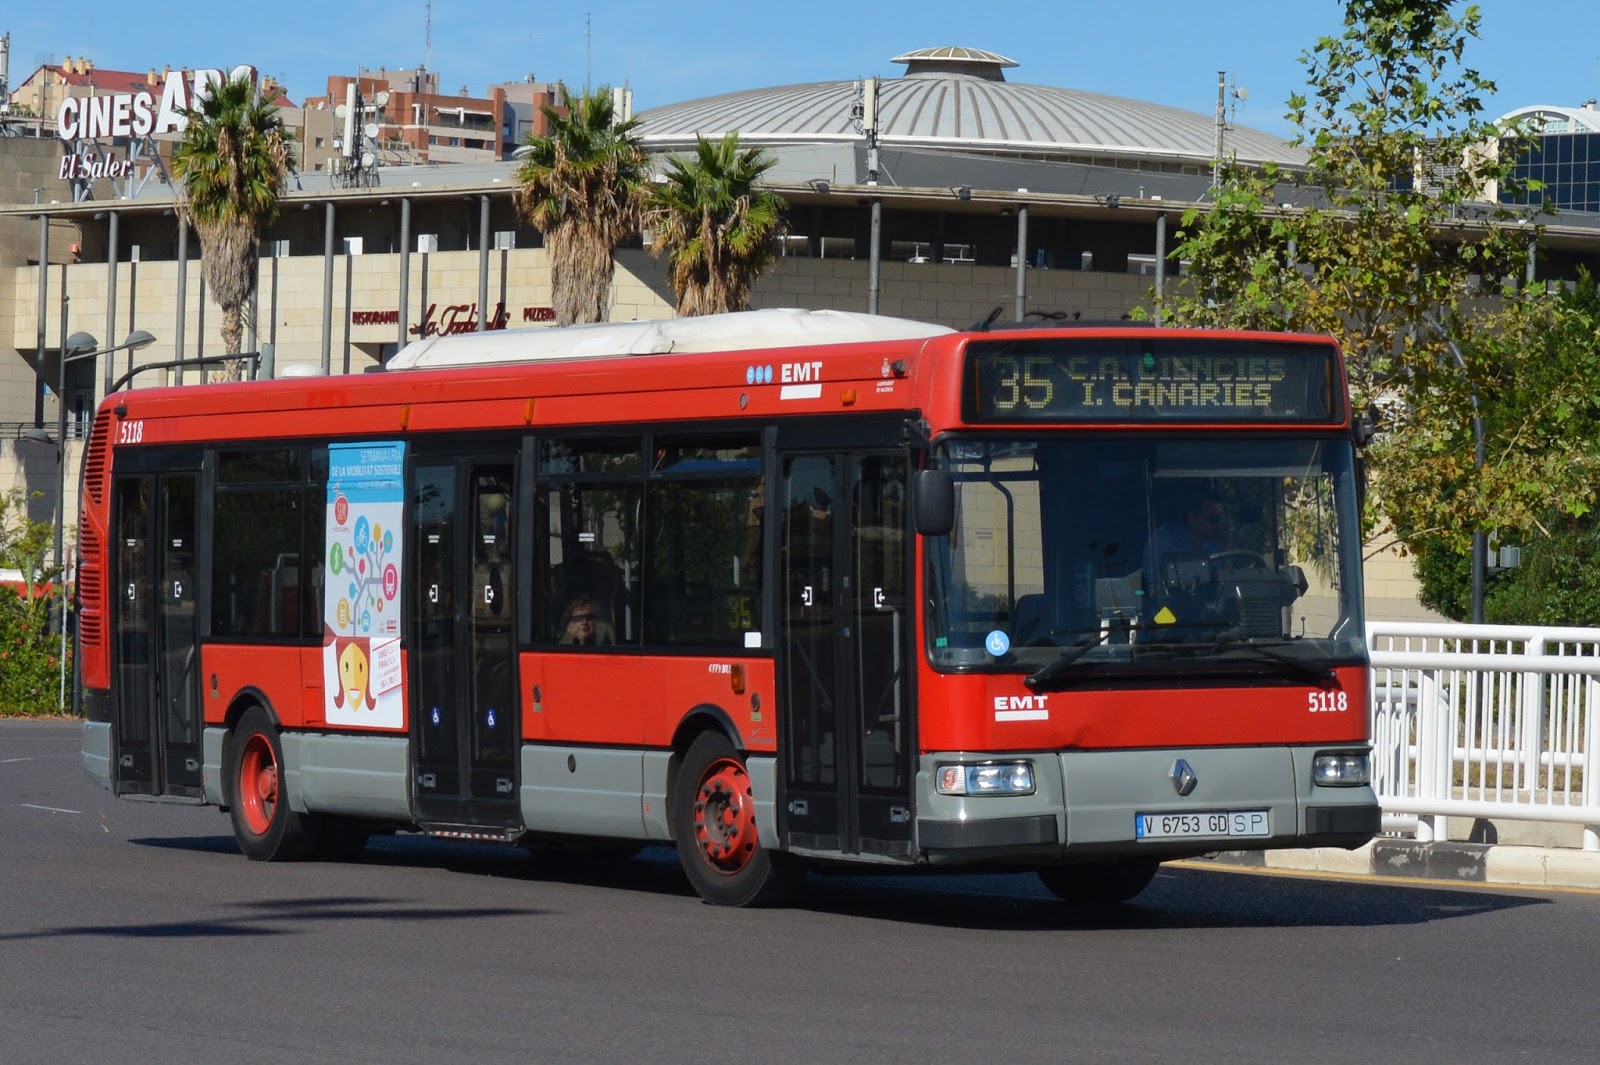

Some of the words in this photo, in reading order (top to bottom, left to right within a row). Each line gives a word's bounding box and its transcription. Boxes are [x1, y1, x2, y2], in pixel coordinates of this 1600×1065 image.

[58, 92, 155, 140] CINES
[59, 153, 77, 180] El
[80, 152, 134, 179] Saler
[781, 362, 822, 383] EMT
[993, 356, 1053, 409] 35
[1112, 383, 1272, 406] CANARIES
[120, 420, 144, 444] 5118
[331, 466, 339, 477] DE
[339, 466, 346, 477] LA
[994, 695, 1048, 710] EMT
[1308, 691, 1348, 712] 5118
[1144, 817, 1153, 834] V
[1162, 816, 1200, 834] 6753
[1208, 815, 1227, 832] GD
